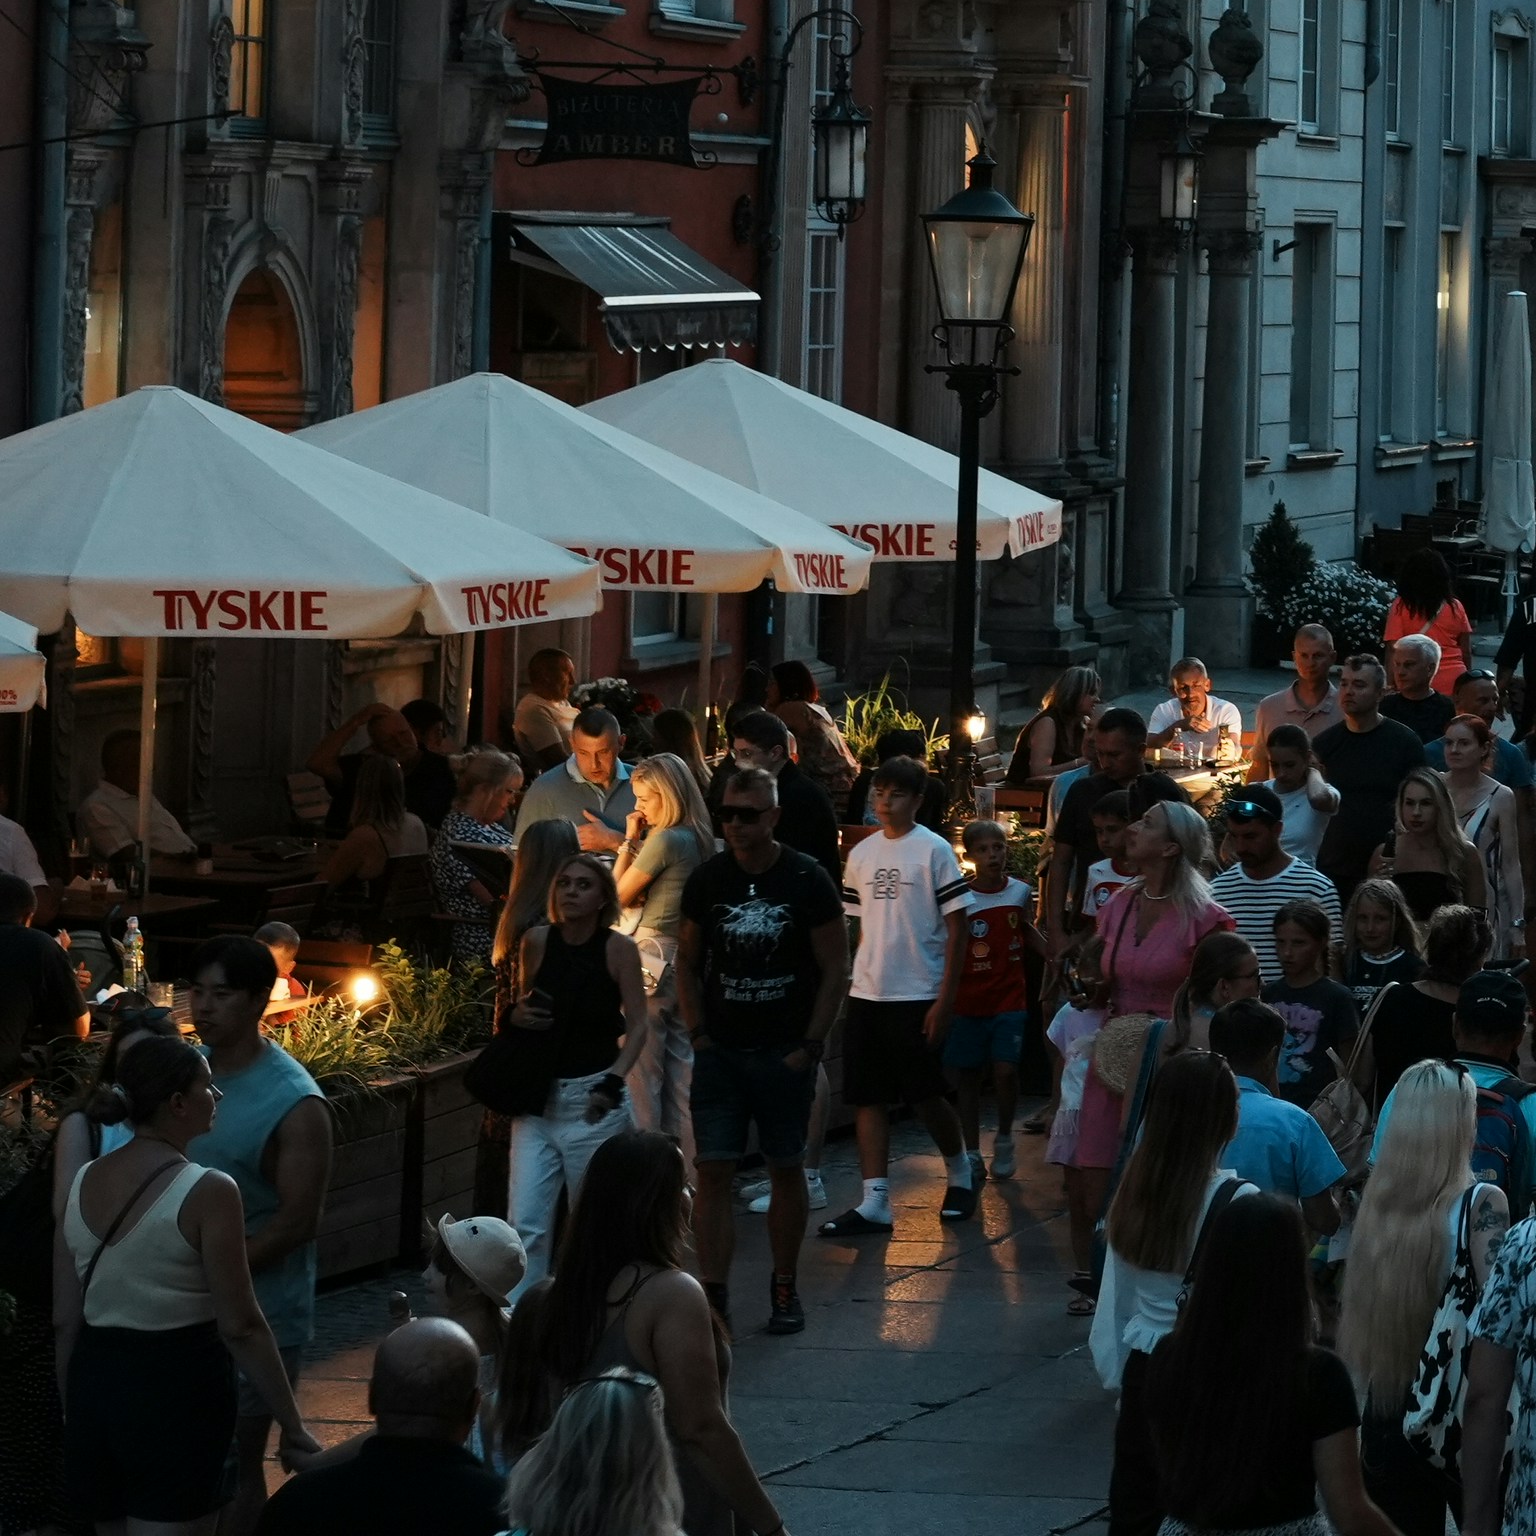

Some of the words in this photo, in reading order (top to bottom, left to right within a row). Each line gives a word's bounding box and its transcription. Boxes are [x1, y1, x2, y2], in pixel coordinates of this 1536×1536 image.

[552, 133, 676, 156] AMBER
[830, 524, 936, 557] SKIE
[1017, 511, 1045, 548] TYSKIE
[566, 547, 695, 586] SKIE
[794, 554, 848, 589] TYSKIE
[153, 589, 329, 632] TYSKIE
[461, 578, 550, 626] TYSKIE
[873, 868, 901, 900] 23
[724, 987, 753, 1001] Black
[754, 988, 786, 1003] Metal
